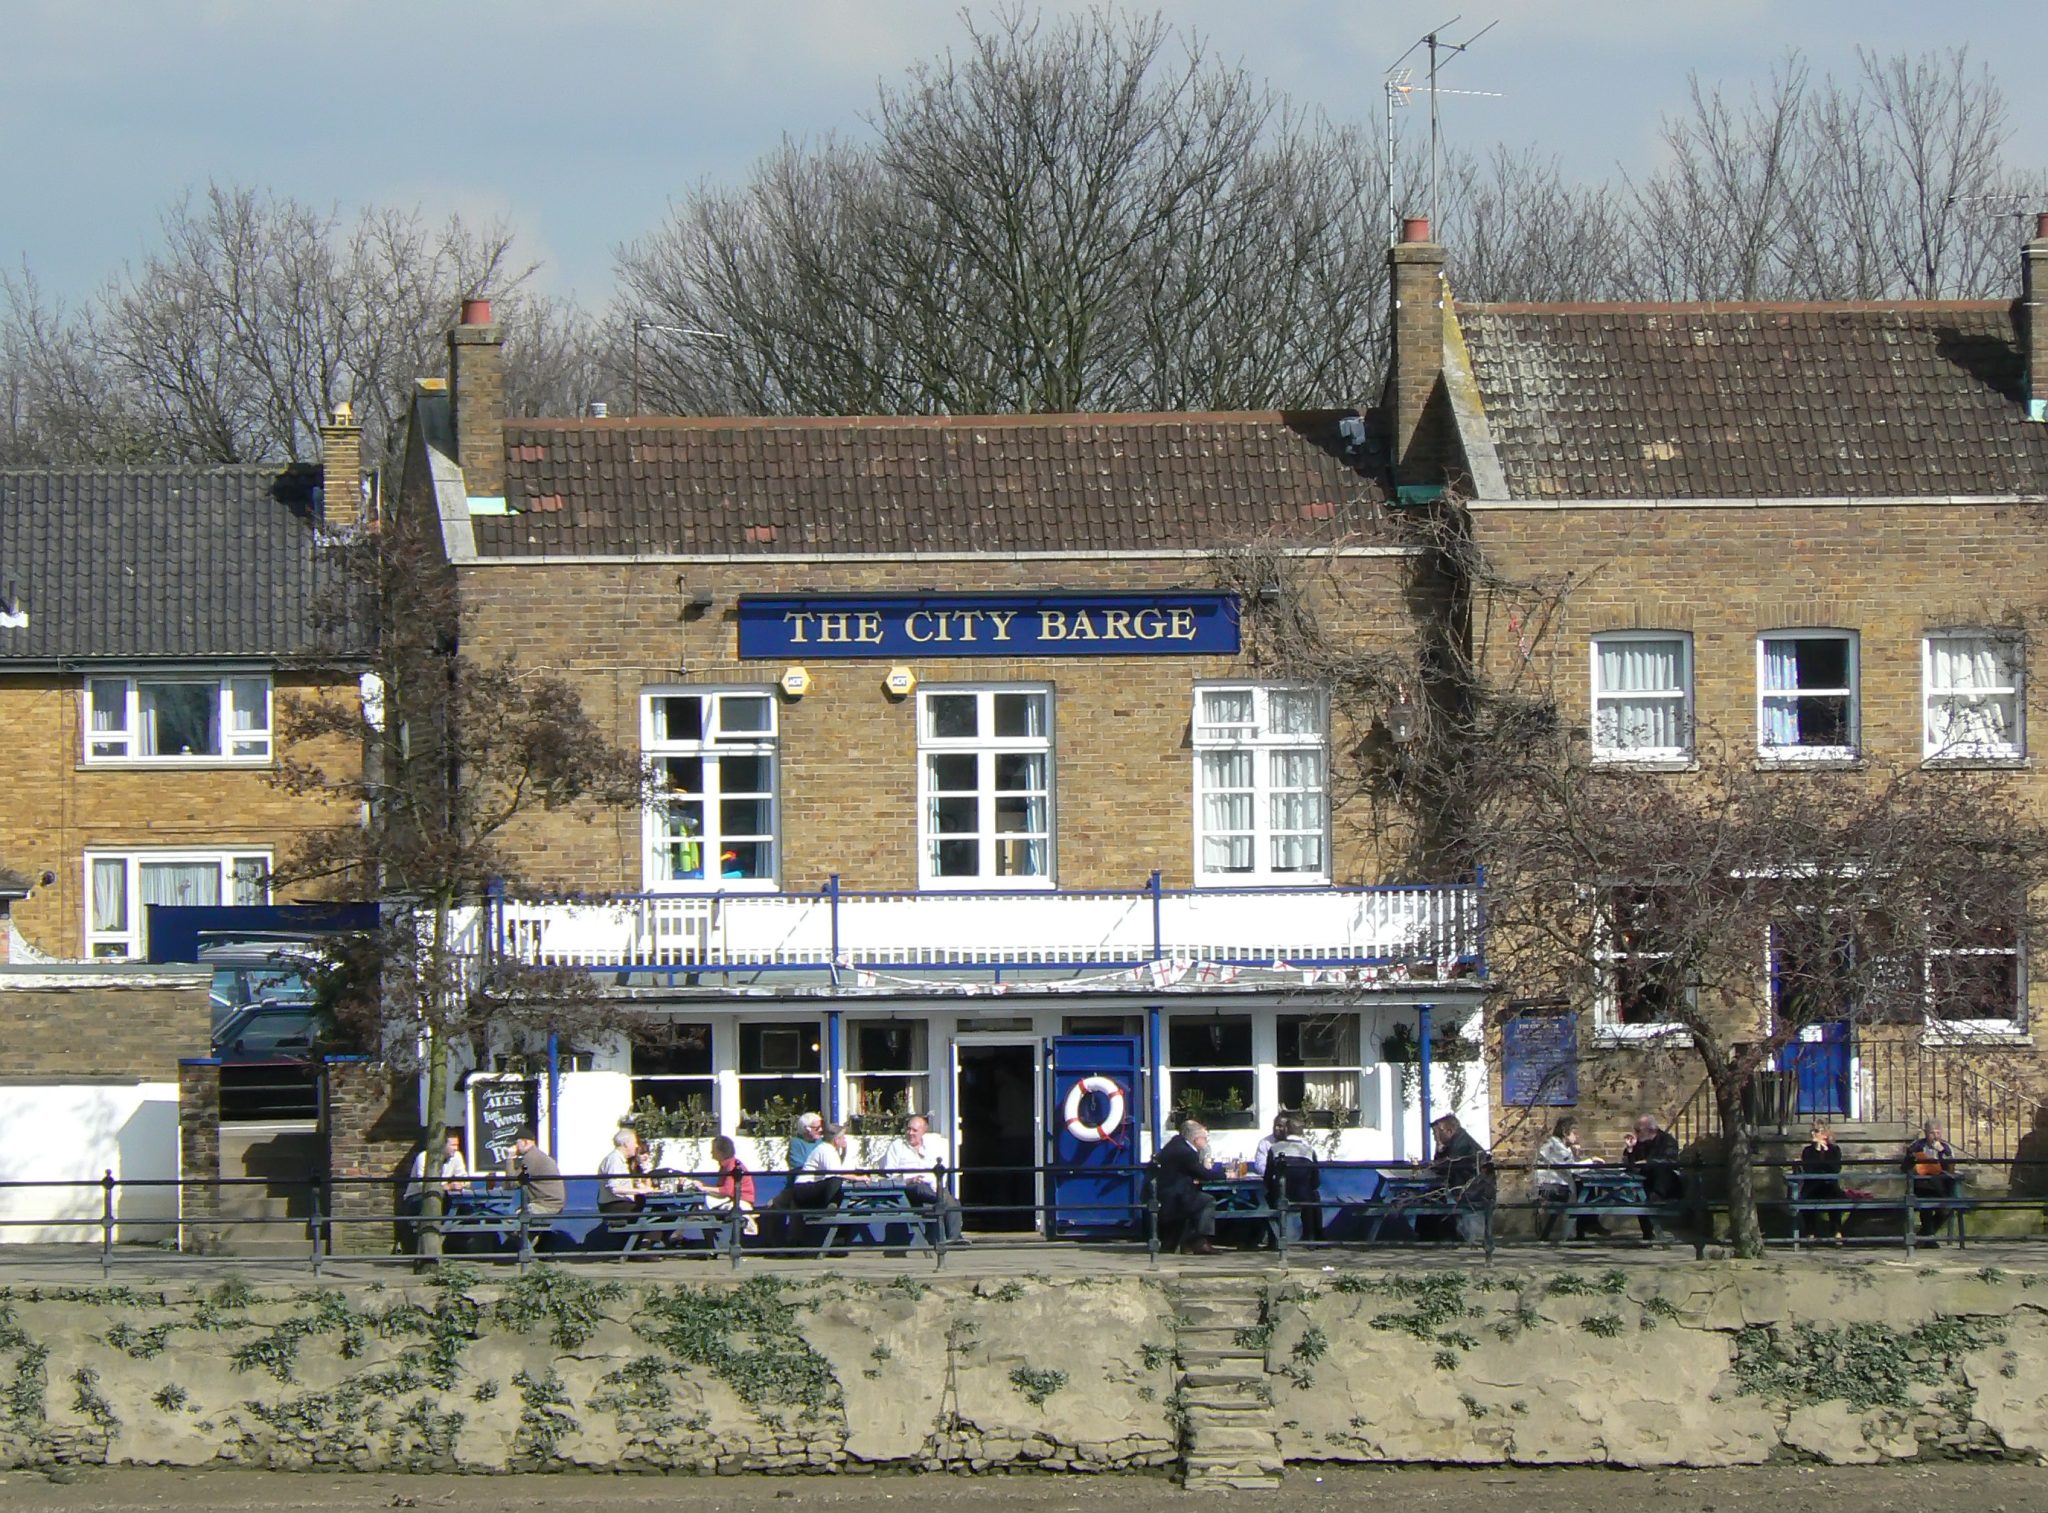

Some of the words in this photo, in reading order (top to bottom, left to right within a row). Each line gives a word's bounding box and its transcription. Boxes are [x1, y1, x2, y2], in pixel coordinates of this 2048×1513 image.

[784, 610, 884, 644] THE
[904, 610, 1018, 642] CITY
[1037, 607, 1197, 641] BARGE
[484, 1095, 523, 1109] ALES
